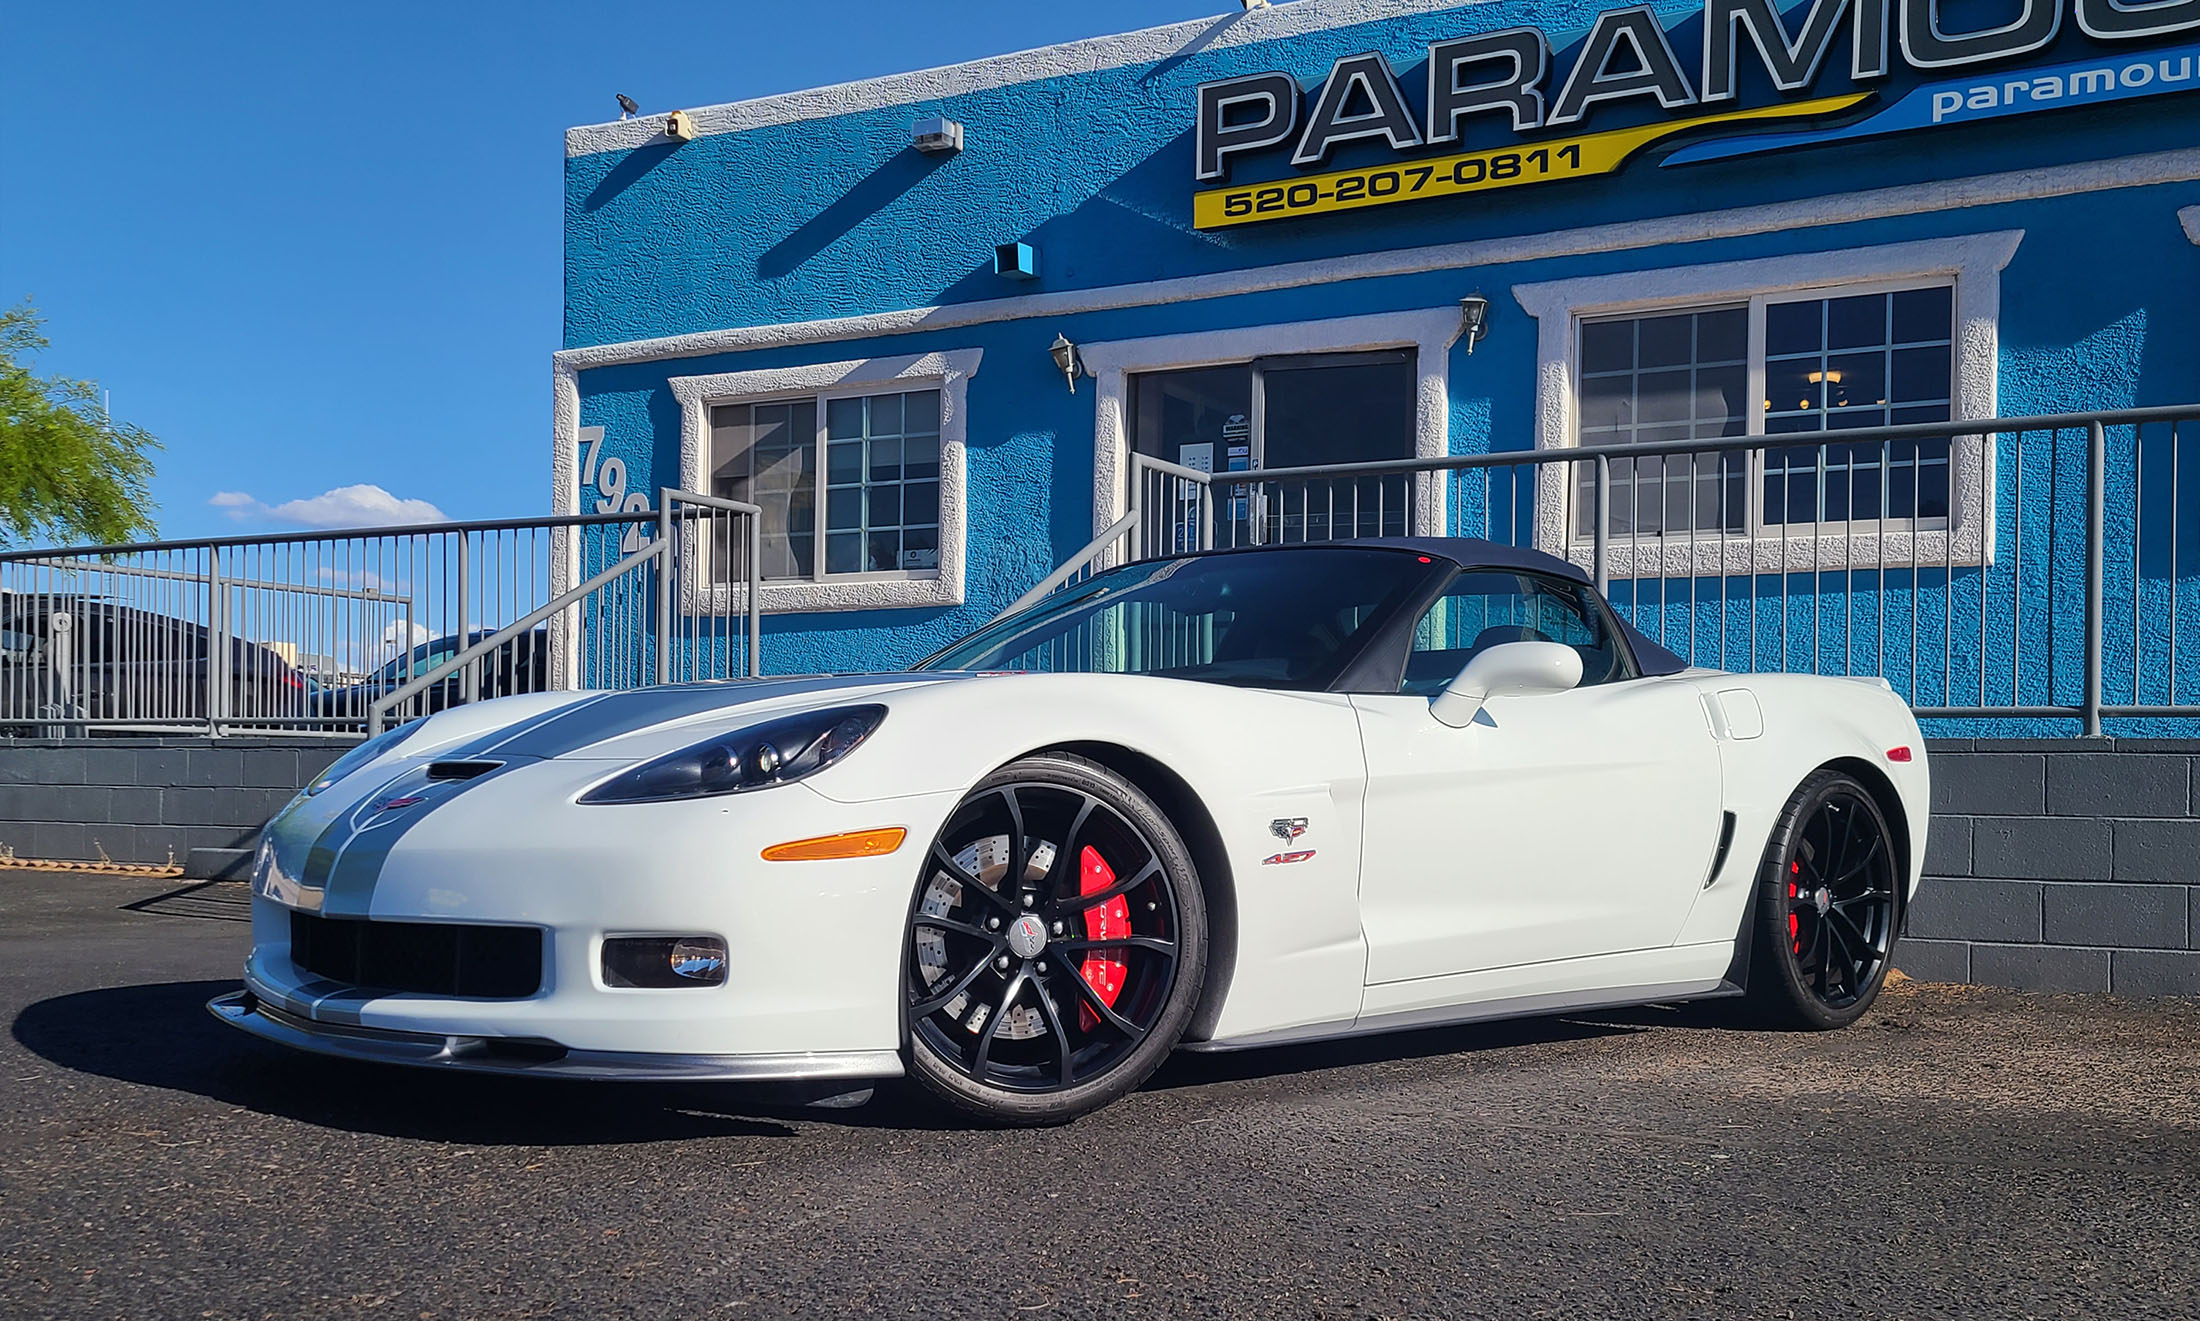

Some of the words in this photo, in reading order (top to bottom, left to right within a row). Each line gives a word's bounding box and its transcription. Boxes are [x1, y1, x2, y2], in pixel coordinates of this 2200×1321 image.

[1195, 0, 2200, 181] PARAM
[1932, 55, 2200, 123] paramou
[1224, 144, 1581, 218] 520-207-0811
